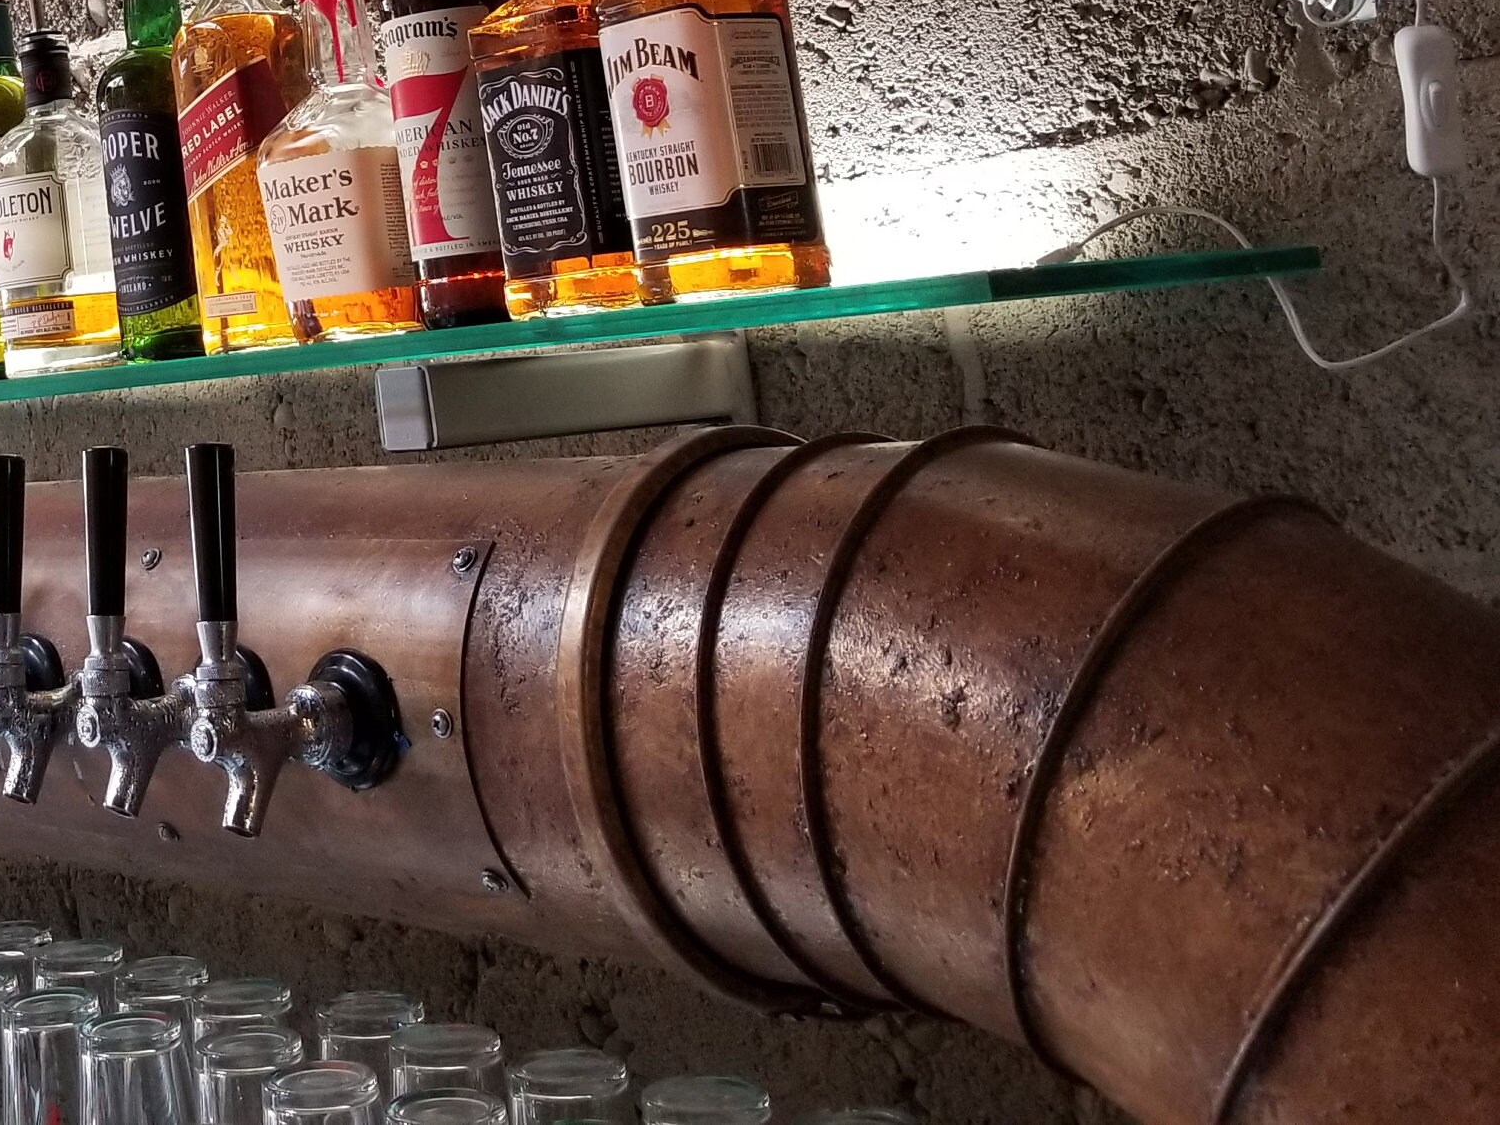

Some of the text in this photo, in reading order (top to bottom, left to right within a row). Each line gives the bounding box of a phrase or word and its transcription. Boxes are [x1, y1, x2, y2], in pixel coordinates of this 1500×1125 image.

[381, 16, 458, 52] eagram's
[606, 48, 633, 100] JIM
[634, 37, 700, 82] BEAM
[481, 81, 572, 133] JACK DANIEL'S
[181, 101, 243, 160] RED LABEL
[396, 119, 473, 145] MERICAN
[517, 122, 531, 131] Old
[102, 130, 160, 166] ROPER
[626, 140, 696, 164] KENTUCKY STRAIGHT
[502, 158, 562, 180] Tennessee
[628, 152, 700, 187] BOURBON
[263, 168, 353, 203] Maker's
[506, 180, 564, 202] WHISKEY
[648, 180, 680, 196] WHISKEY
[109, 201, 167, 239] WELVE
[287, 195, 359, 228] Mark
[284, 233, 345, 255] WHISKY
[651, 219, 691, 243] 225
[123, 248, 173, 264] WHISKEY
